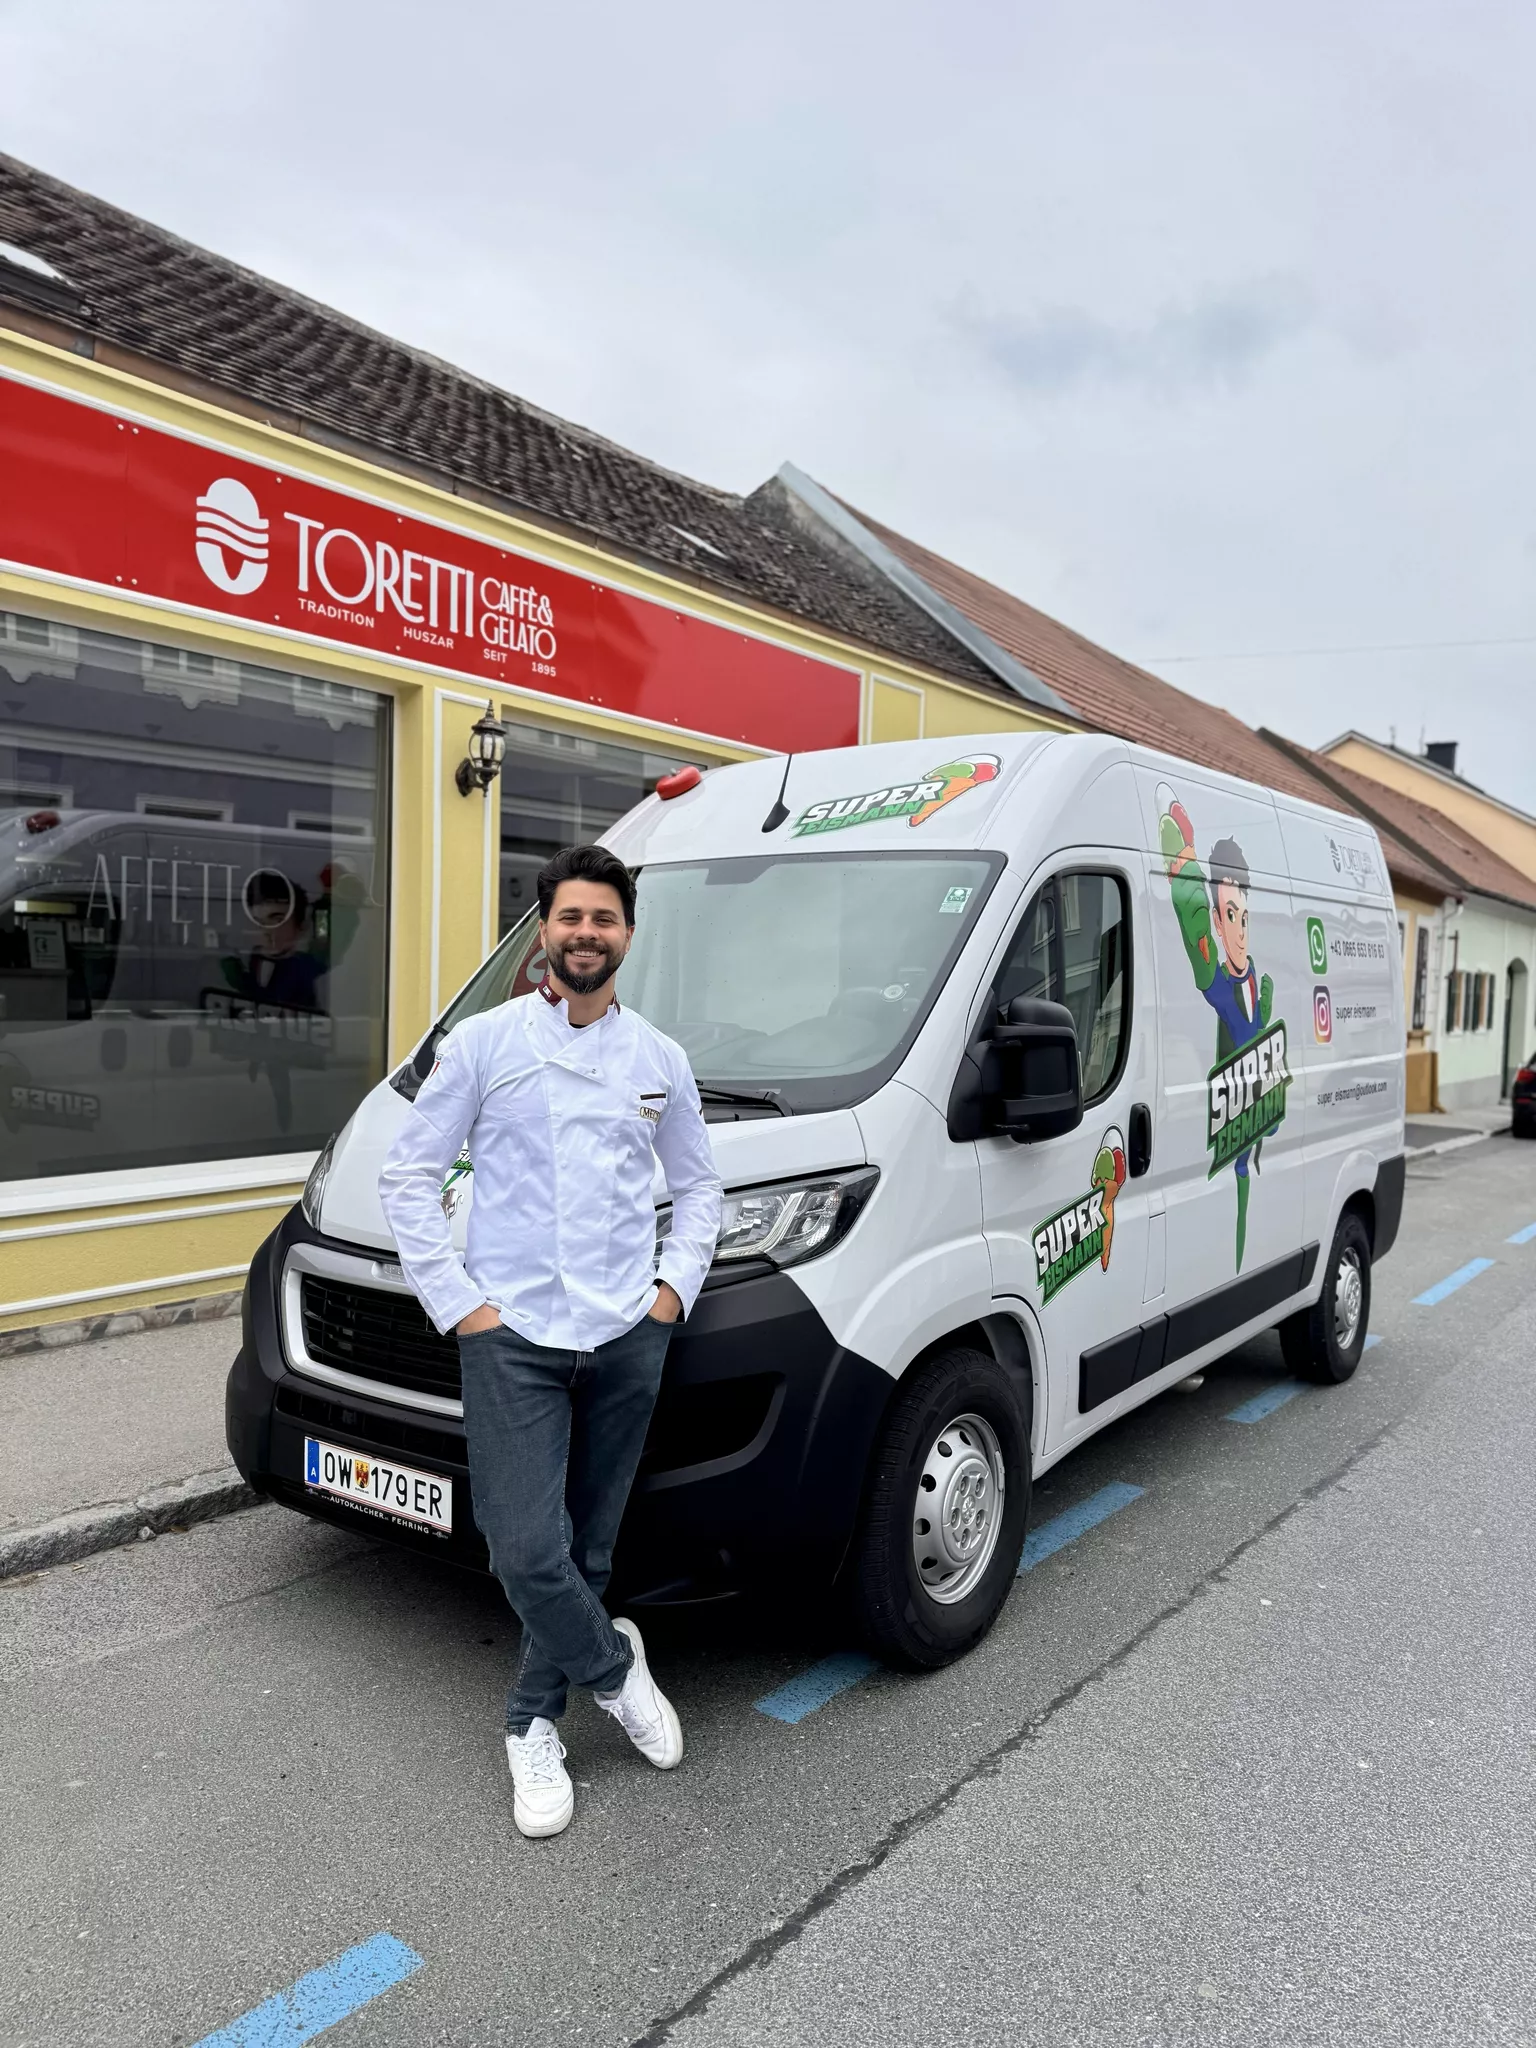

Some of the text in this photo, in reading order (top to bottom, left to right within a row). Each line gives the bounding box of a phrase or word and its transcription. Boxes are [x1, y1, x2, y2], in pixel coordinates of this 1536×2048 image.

[283, 512, 475, 637] TORETTI
[298, 598, 556, 677] TRADITION HUSZAR SEIT 1895
[480, 613, 556, 660] GELATO
[801, 781, 944, 824] SUPER
[804, 801, 924, 834] EISMANN
[86, 854, 295, 928] AFFETTO
[1330, 939, 1342, 956] +43
[1210, 1029, 1288, 1136] SUPER
[1317, 1081, 1388, 1107] super_eismann@outlook.com
[1215, 1082, 1285, 1164] EISMANN
[1034, 1190, 1108, 1277] SUPER
[1045, 1228, 1103, 1295] EISMANN
[310, 1467, 317, 1478] A
[324, 1451, 353, 1489] OW
[391, 1516, 430, 1534] FEHRING
